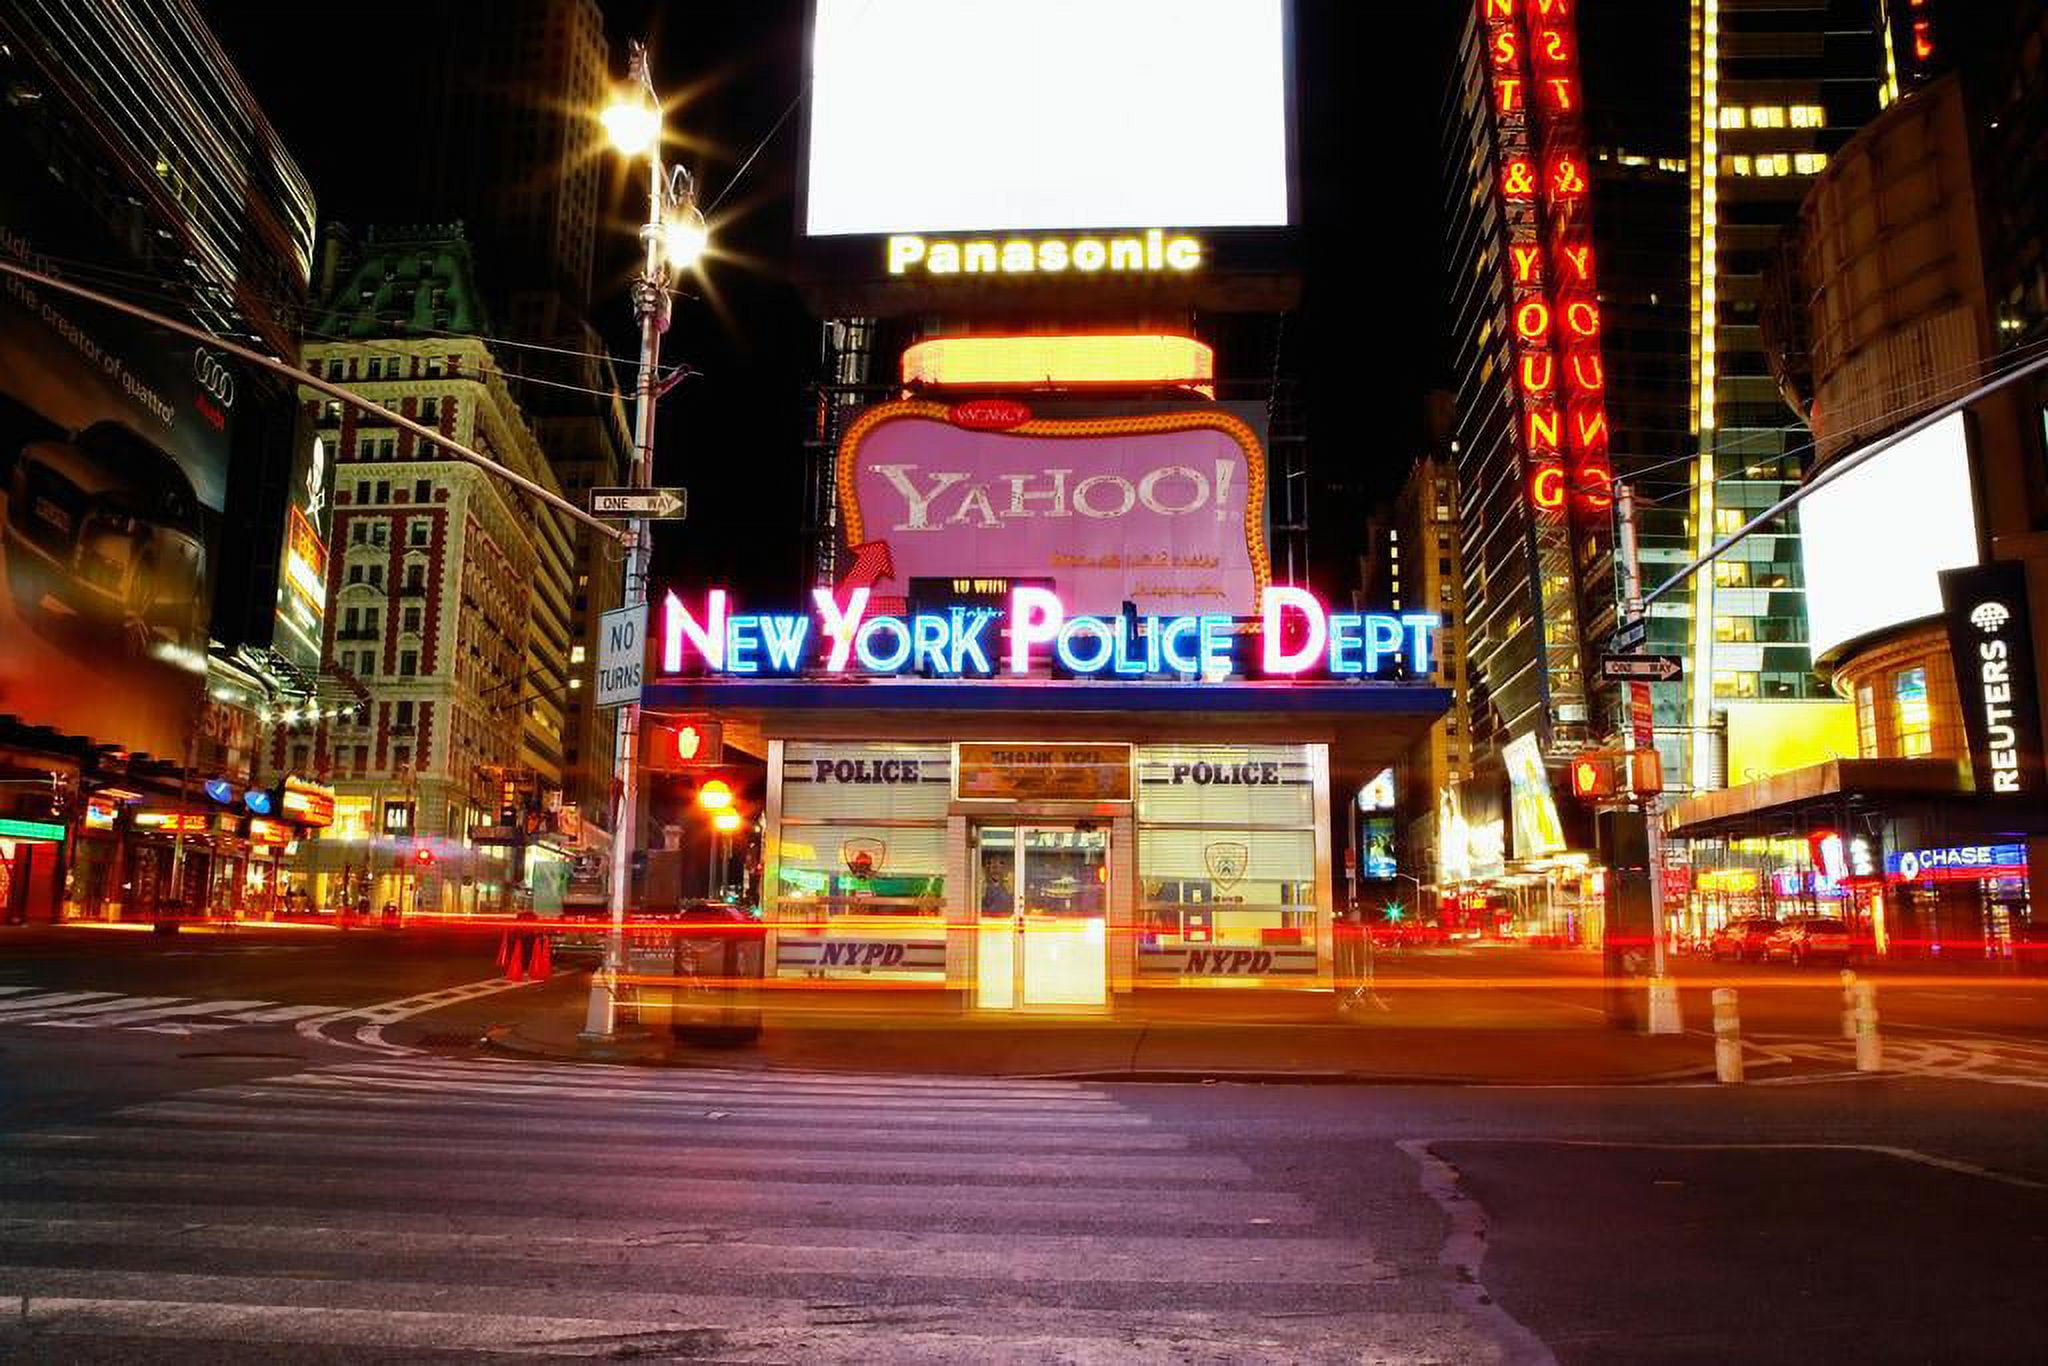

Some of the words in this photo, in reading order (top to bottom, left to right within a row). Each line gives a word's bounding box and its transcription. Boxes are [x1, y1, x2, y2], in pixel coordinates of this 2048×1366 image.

[1504, 162, 1533, 193] &
[887, 228, 1203, 274] Panasonic
[42, 303, 100, 362] creator
[104, 355, 121, 379] of
[1514, 248, 1564, 506] YOUNG
[603, 497, 628, 509] ONE
[650, 498, 674, 509] WAY
[867, 458, 1236, 532] YAHOO!
[610, 621, 635, 654] NO
[663, 587, 809, 673] NEW
[812, 587, 992, 673] YORK
[1011, 587, 1234, 674] POLICE
[1263, 586, 1440, 674] DEPT
[600, 663, 641, 693] TURNS
[1612, 663, 1632, 673] ONE
[1649, 663, 1672, 673] WAY
[1980, 639, 2020, 793] REUTERS
[815, 760, 921, 784] POLICE
[1172, 761, 1280, 785] POLICE
[1920, 847, 1992, 866] CHASE
[819, 942, 905, 966] NYPD
[1184, 949, 1273, 974] NYPD
